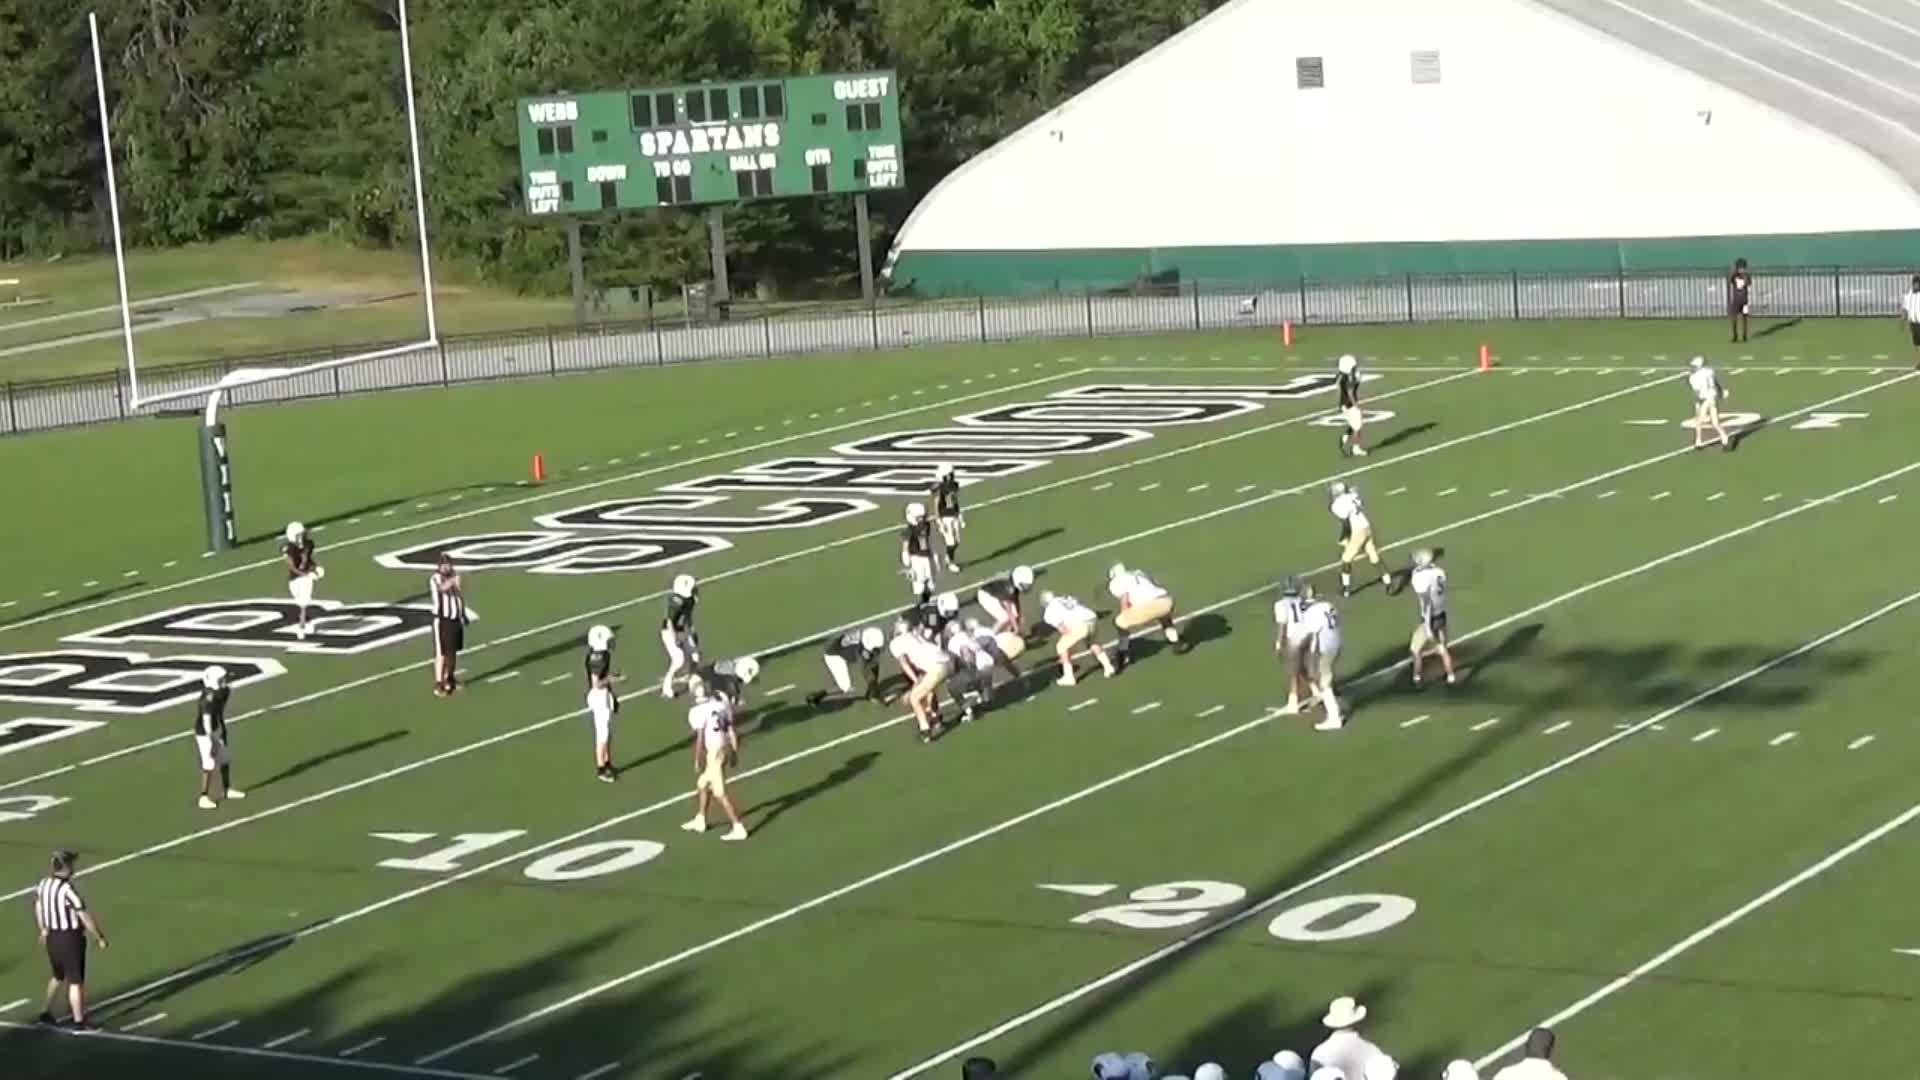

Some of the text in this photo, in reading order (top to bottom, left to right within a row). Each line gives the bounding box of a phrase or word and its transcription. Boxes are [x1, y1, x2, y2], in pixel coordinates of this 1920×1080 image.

[834, 77, 888, 100] GUEST
[528, 101, 578, 123] WEBB
[640, 122, 780, 157] SPARTANS
[653, 159, 692, 178] TO GO
[373, 374, 1385, 574] SCHOOL
[377, 829, 666, 882] 10
[1069, 880, 1417, 942] 20
